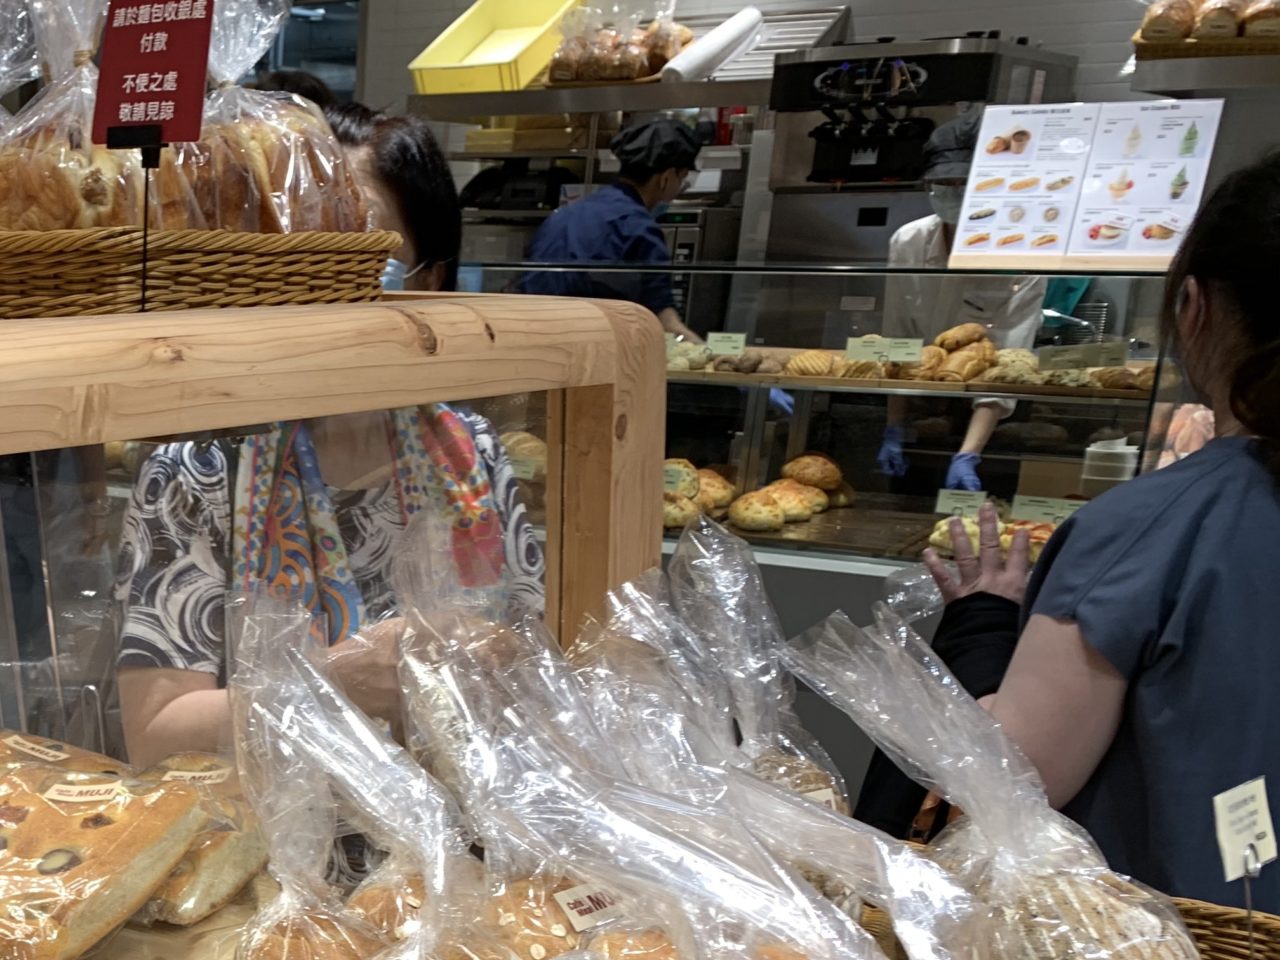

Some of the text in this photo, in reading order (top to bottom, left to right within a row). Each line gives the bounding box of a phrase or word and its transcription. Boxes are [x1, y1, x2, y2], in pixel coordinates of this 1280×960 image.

[140, 32, 168, 53] 付款
[122, 71, 178, 94] 不便之處
[119, 100, 175, 122] 敬請見諒
[29, 745, 62, 761] MUJI
[75, 787, 115, 798] MUJI
